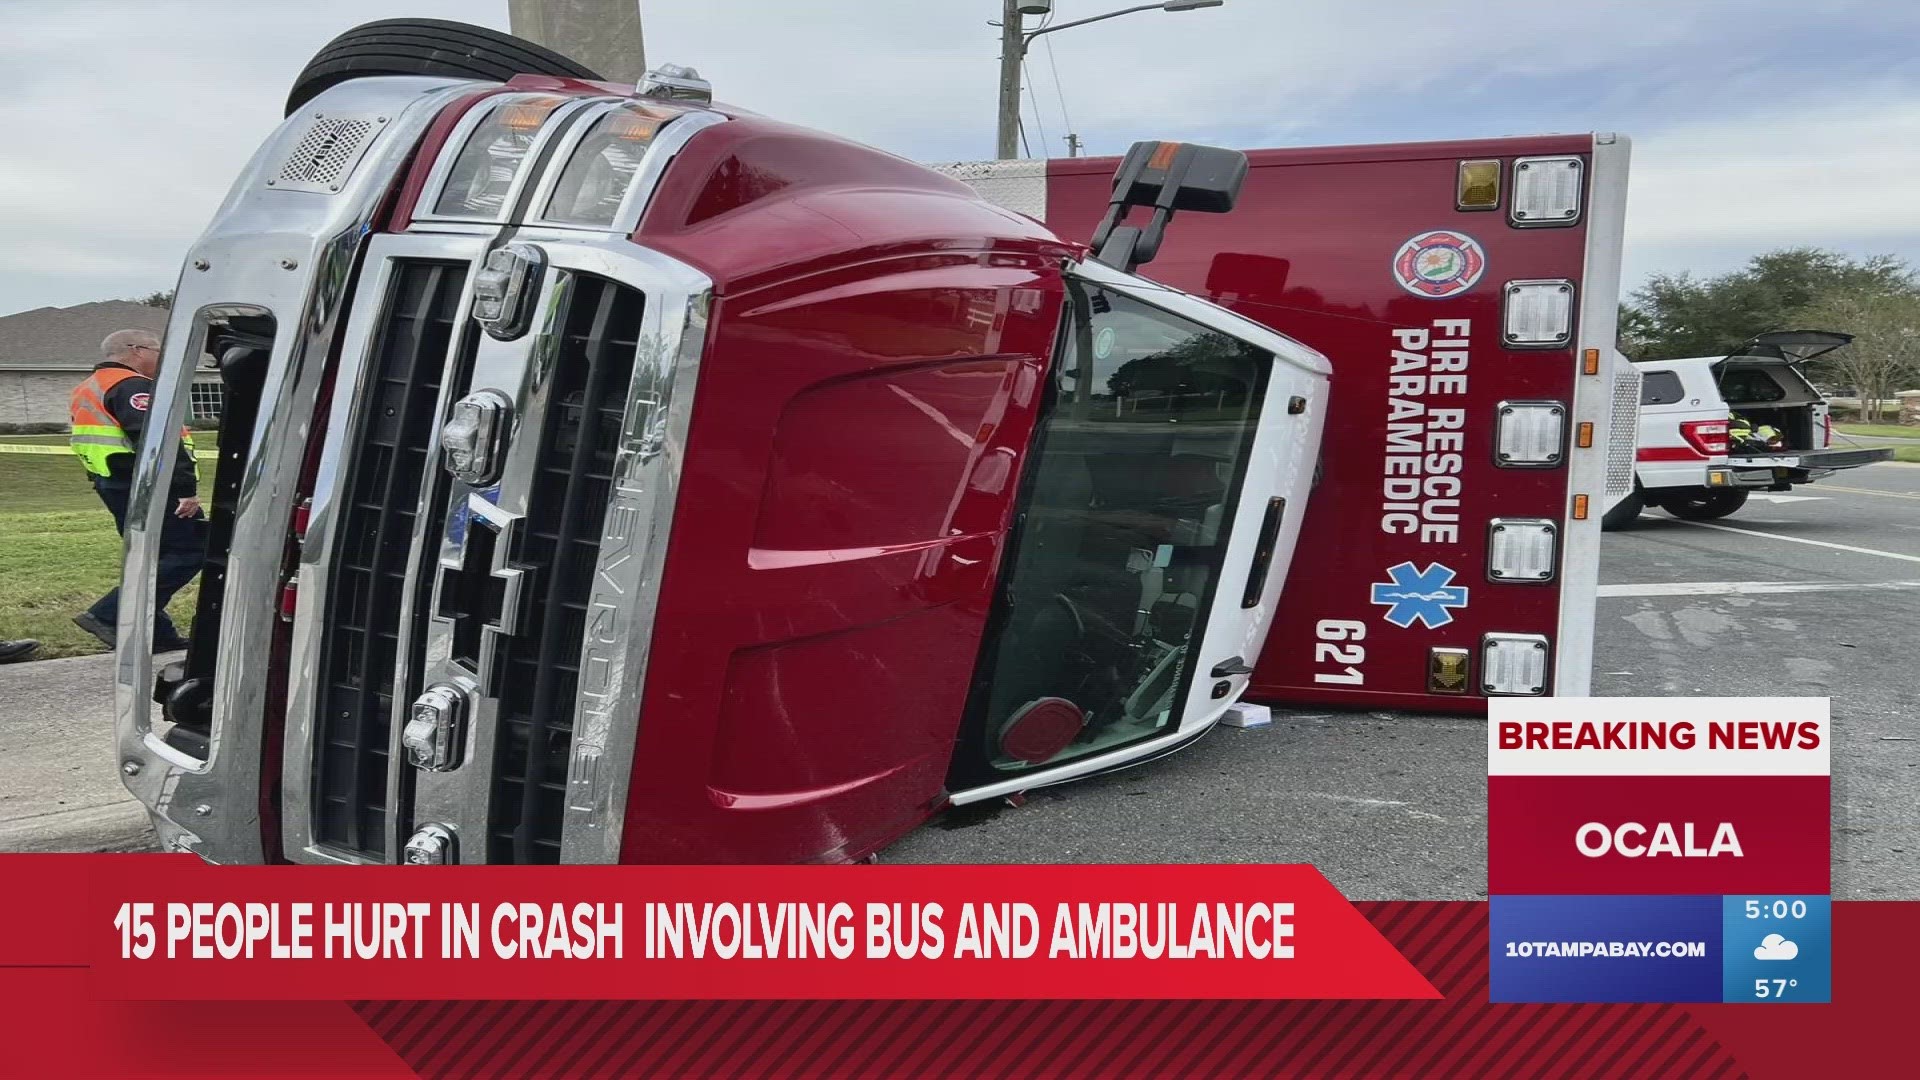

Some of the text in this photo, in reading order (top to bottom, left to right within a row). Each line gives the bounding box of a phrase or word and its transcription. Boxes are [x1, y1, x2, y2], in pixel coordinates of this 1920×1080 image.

[1381, 328, 1430, 535] PARAMEDIC
[1419, 318, 1471, 544] FIRE RESCUE
[570, 391, 661, 829] CHEVROLET
[1314, 619, 1366, 685] 621
